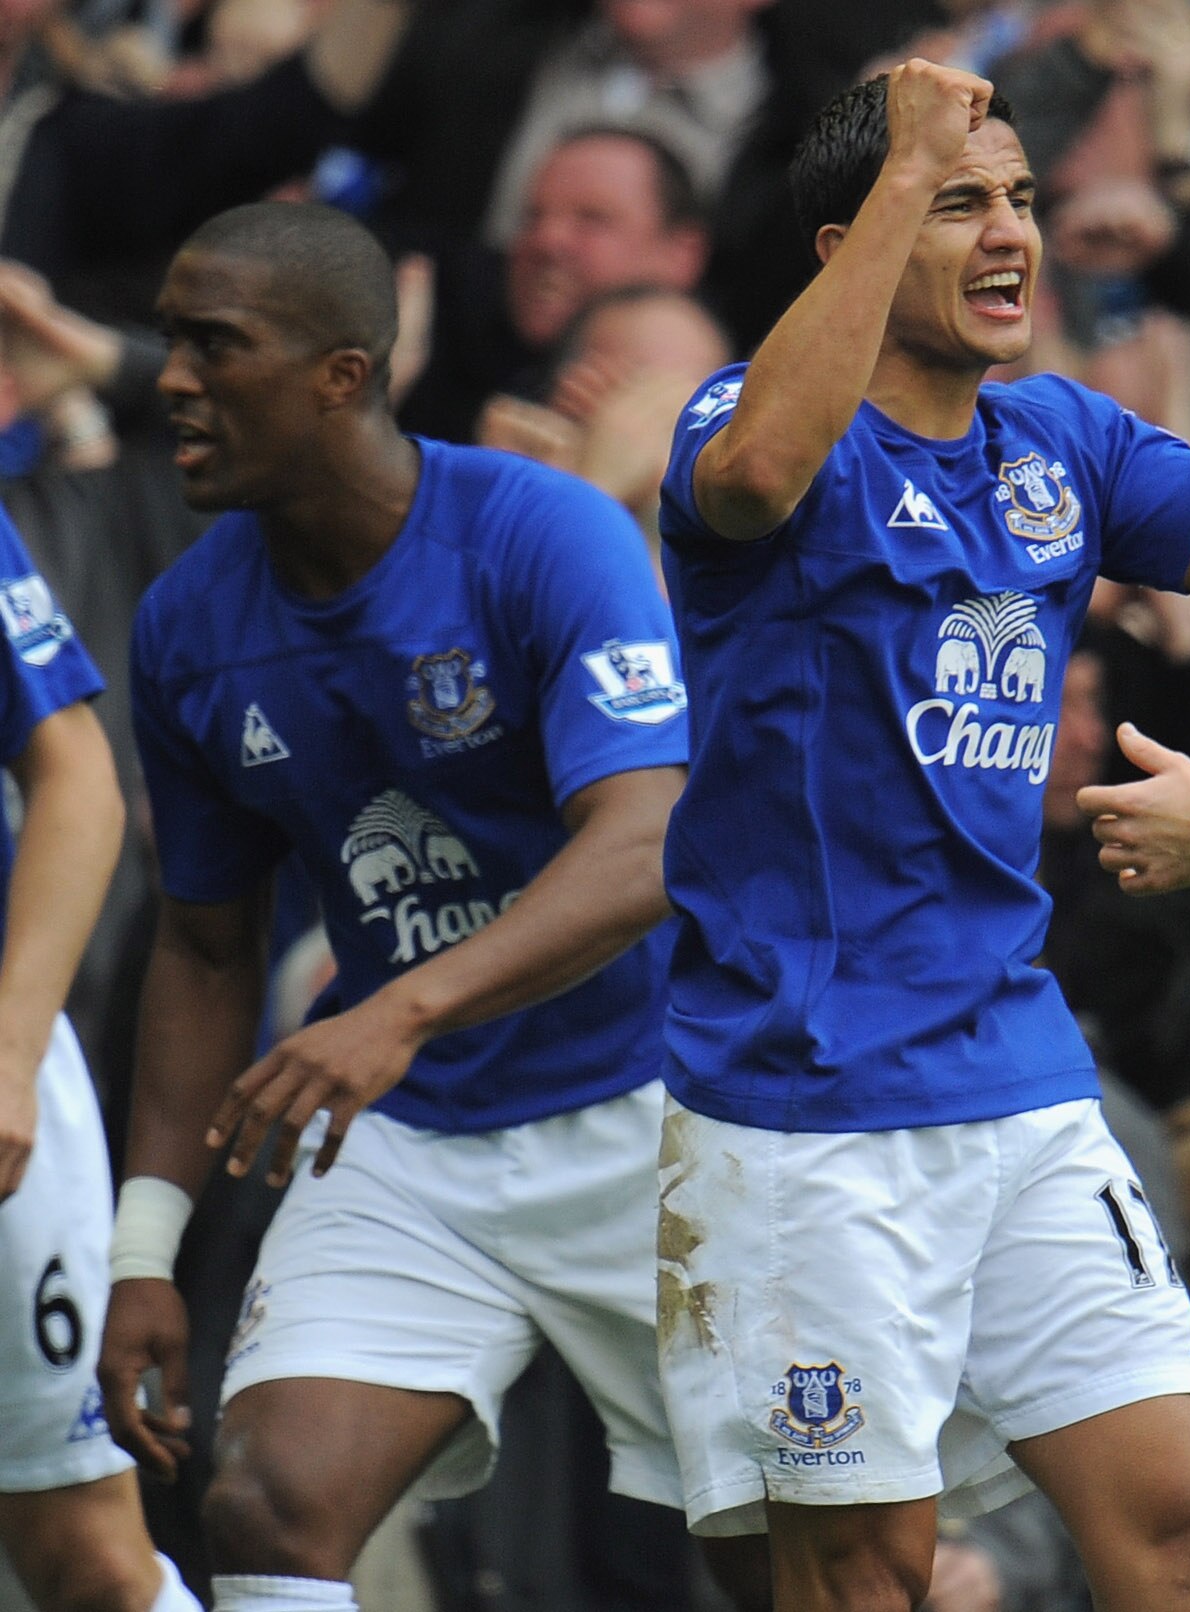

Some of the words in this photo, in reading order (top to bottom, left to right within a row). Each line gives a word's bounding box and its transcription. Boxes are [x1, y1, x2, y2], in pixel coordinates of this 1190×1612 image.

[906, 698, 1056, 785] Chang
[360, 892, 520, 963] han
[34, 1254, 83, 1374] 6
[771, 1381, 787, 1395] 18
[843, 1378, 862, 1394] 78
[777, 1447, 866, 1466] Everton
